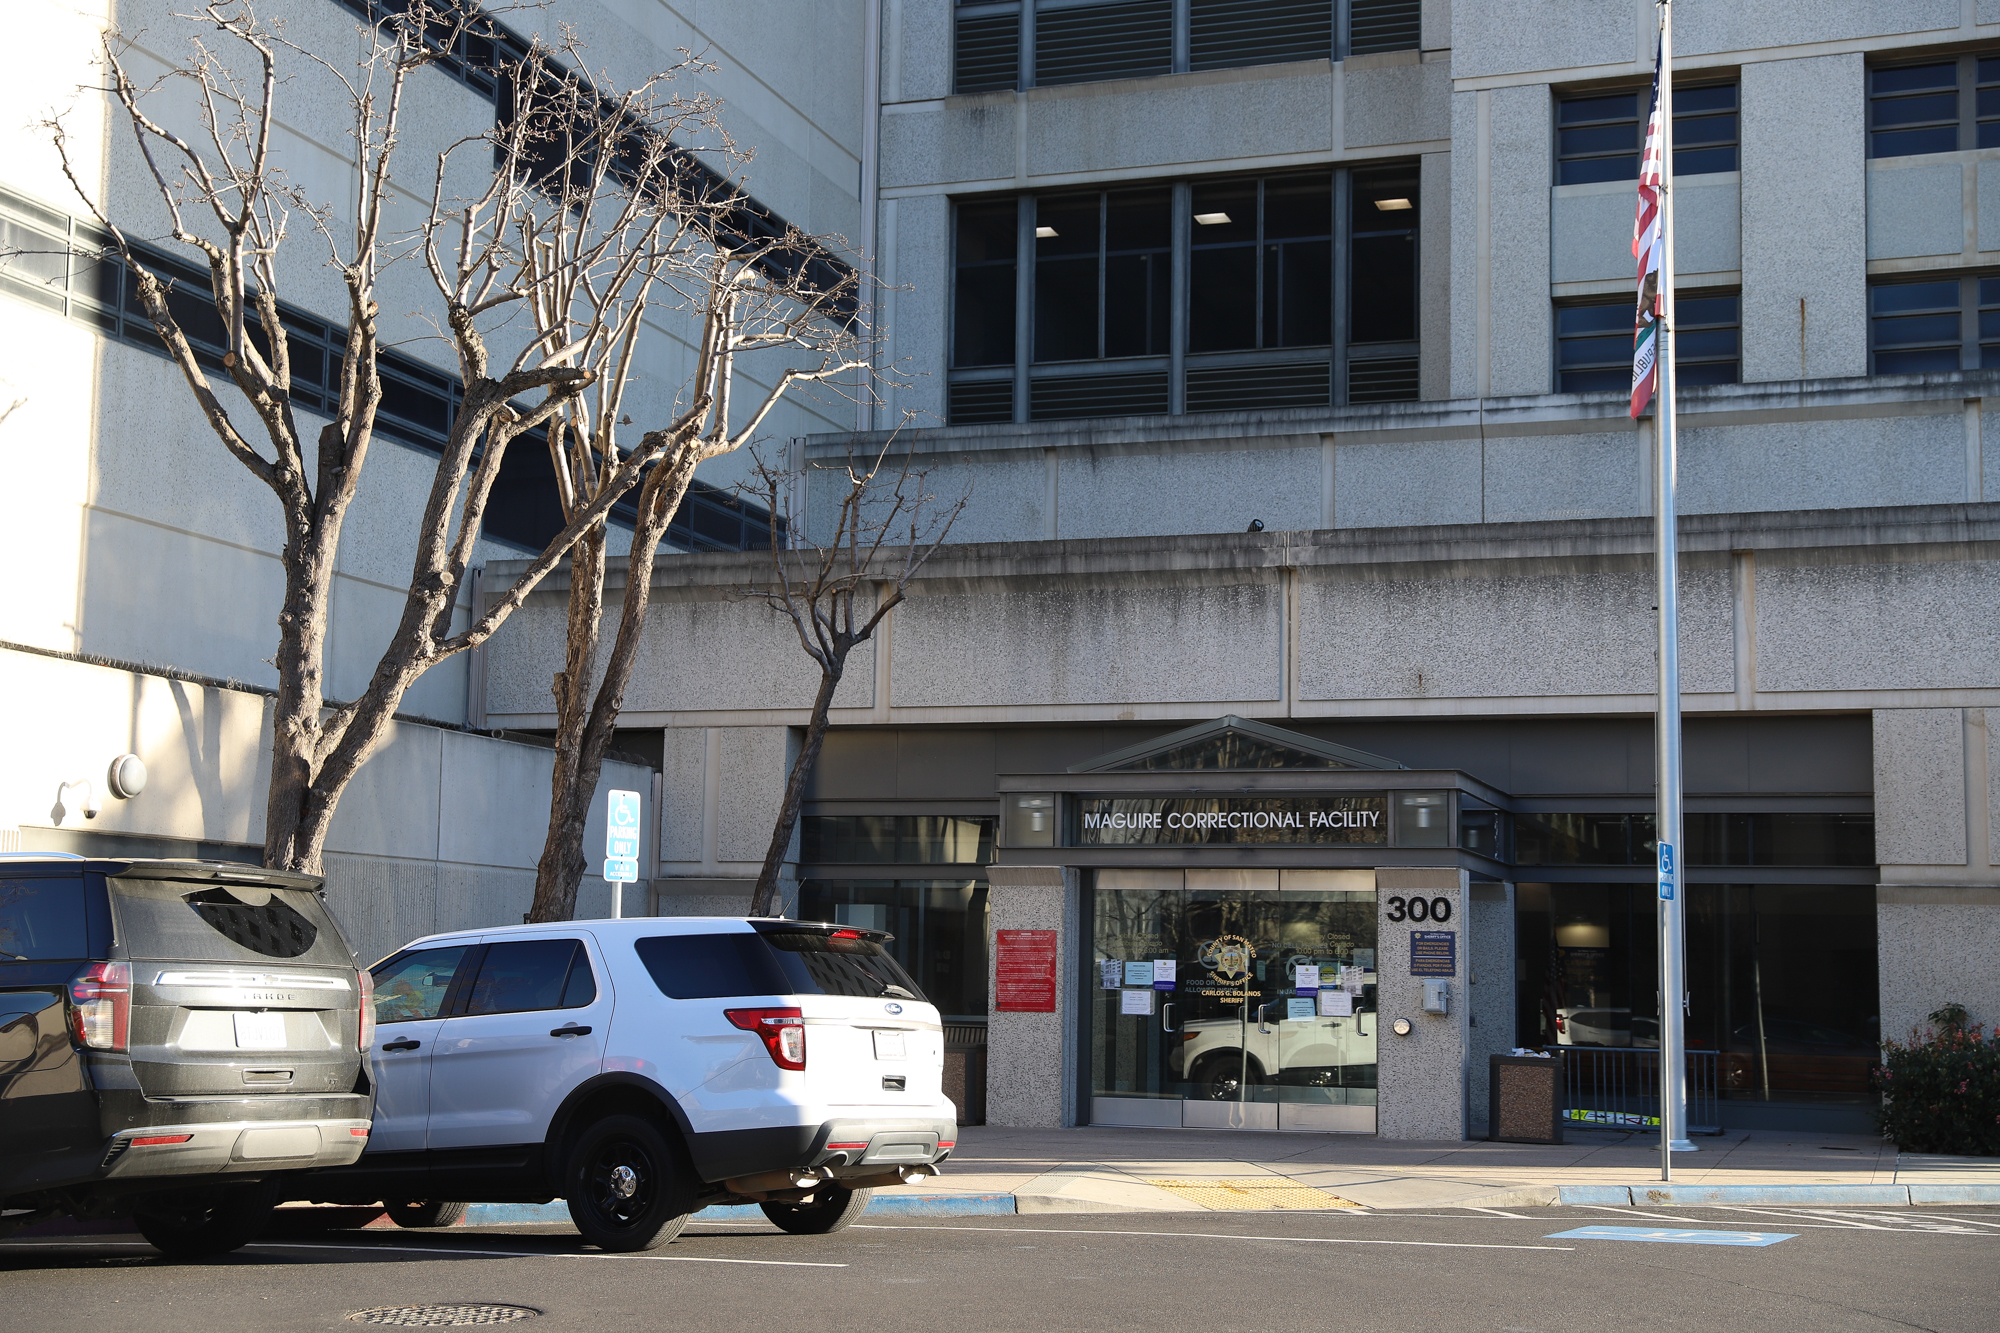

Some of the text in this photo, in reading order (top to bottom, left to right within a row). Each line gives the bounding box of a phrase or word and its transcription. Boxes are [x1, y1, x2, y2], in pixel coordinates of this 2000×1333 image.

[1084, 810, 1380, 829] MAGUIRE CORRECTIONAL FACILITY
[609, 825, 638, 840] PARKING
[613, 840, 632, 854] ONLY
[1387, 896, 1452, 922] 300
[1327, 932, 1351, 940] Closed
[1206, 937, 1223, 957] COUNTY
[1232, 934, 1245, 943] SAN
[1243, 940, 1257, 958] MATEO
[1209, 970, 1235, 986] SHERIFF'S
[1235, 971, 1254, 986] OFFICE
